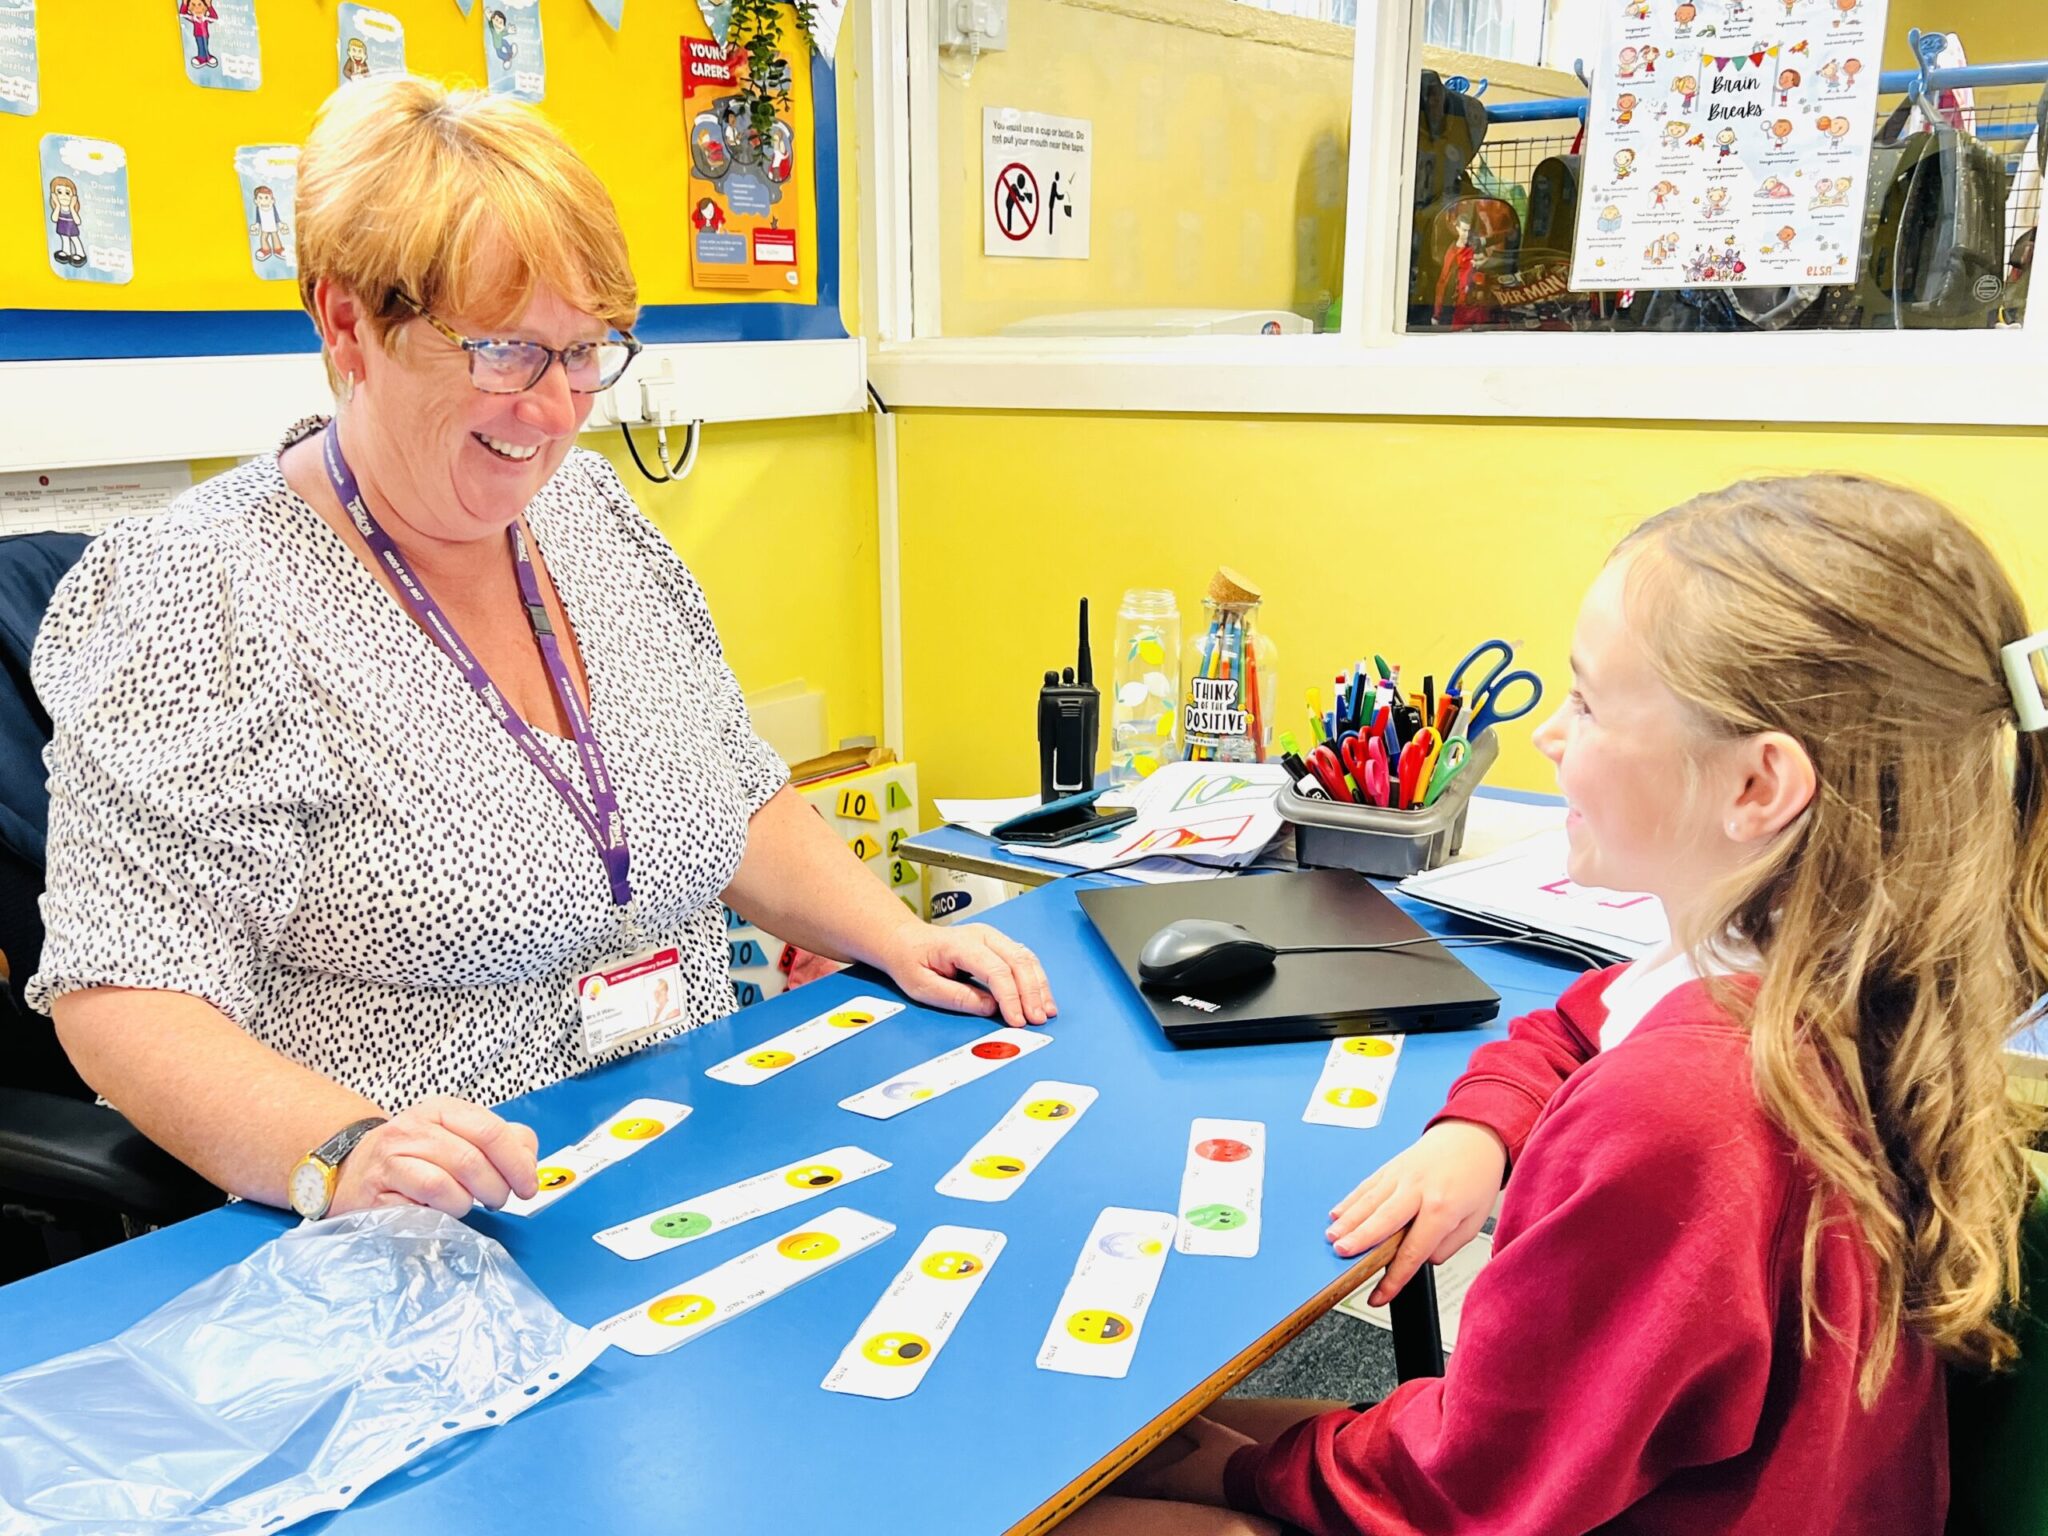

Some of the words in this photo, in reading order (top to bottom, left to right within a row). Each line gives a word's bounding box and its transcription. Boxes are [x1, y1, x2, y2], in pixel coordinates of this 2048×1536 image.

[691, 62, 731, 80] CARERS
[1711, 76, 1760, 95] Brain
[1707, 101, 1764, 121] Breaks
[993, 120, 1005, 130] You
[1006, 123, 1022, 132] must
[1023, 125, 1034, 133] use
[1040, 128, 1051, 137] cup
[1051, 129, 1057, 137] or
[1076, 131, 1084, 140] Do
[992, 134, 1002, 144] not
[1003, 136, 1014, 145] put
[1015, 138, 1029, 147] your
[1030, 138, 1048, 148] mouth
[1049, 141, 1060, 149] near
[1062, 142, 1071, 151] the
[347, 496, 374, 537] UNISON
[1196, 682, 1233, 701] THINK
[481, 682, 510, 724] UNISON
[1201, 701, 1208, 710] OF
[1211, 702, 1223, 711] THE
[1187, 709, 1244, 731] POSITIVE
[843, 792, 866, 816] 10
[890, 786, 896, 808] 1
[608, 811, 625, 849] UNISON
[891, 831, 900, 852] 2
[894, 863, 903, 883] 3
[782, 945, 795, 967] 5
